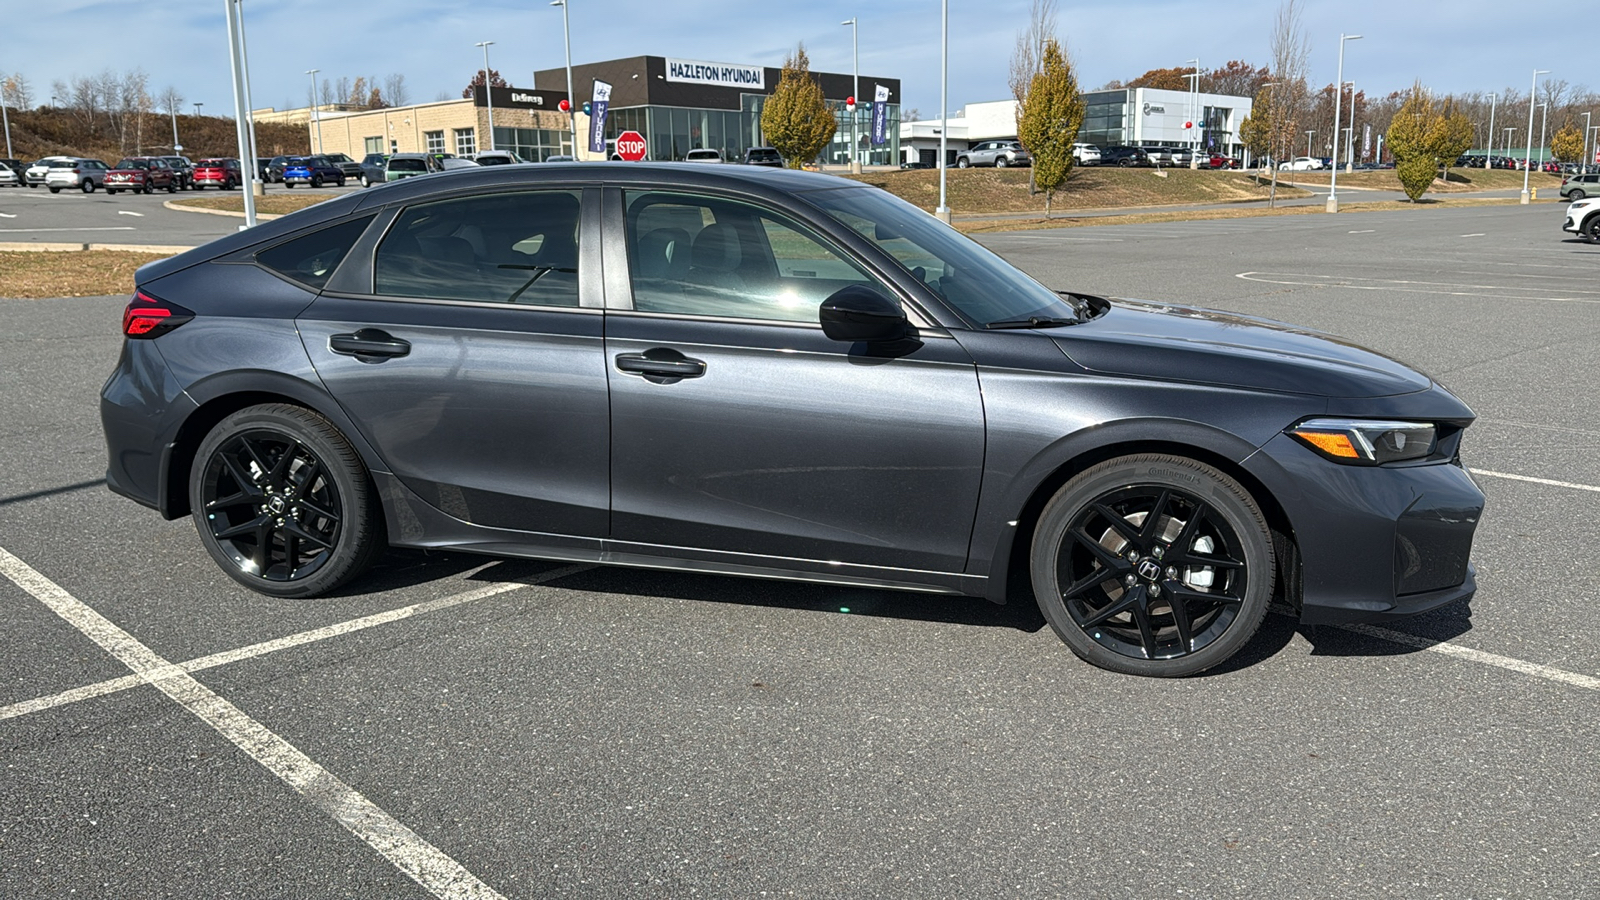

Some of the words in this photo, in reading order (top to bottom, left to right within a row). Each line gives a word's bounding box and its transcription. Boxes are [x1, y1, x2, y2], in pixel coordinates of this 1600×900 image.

[670, 62, 719, 81] HAZLETON
[721, 67, 761, 84] HYUNDAI
[618, 141, 645, 154] STOP
[1148, 466, 1196, 483] Continental
